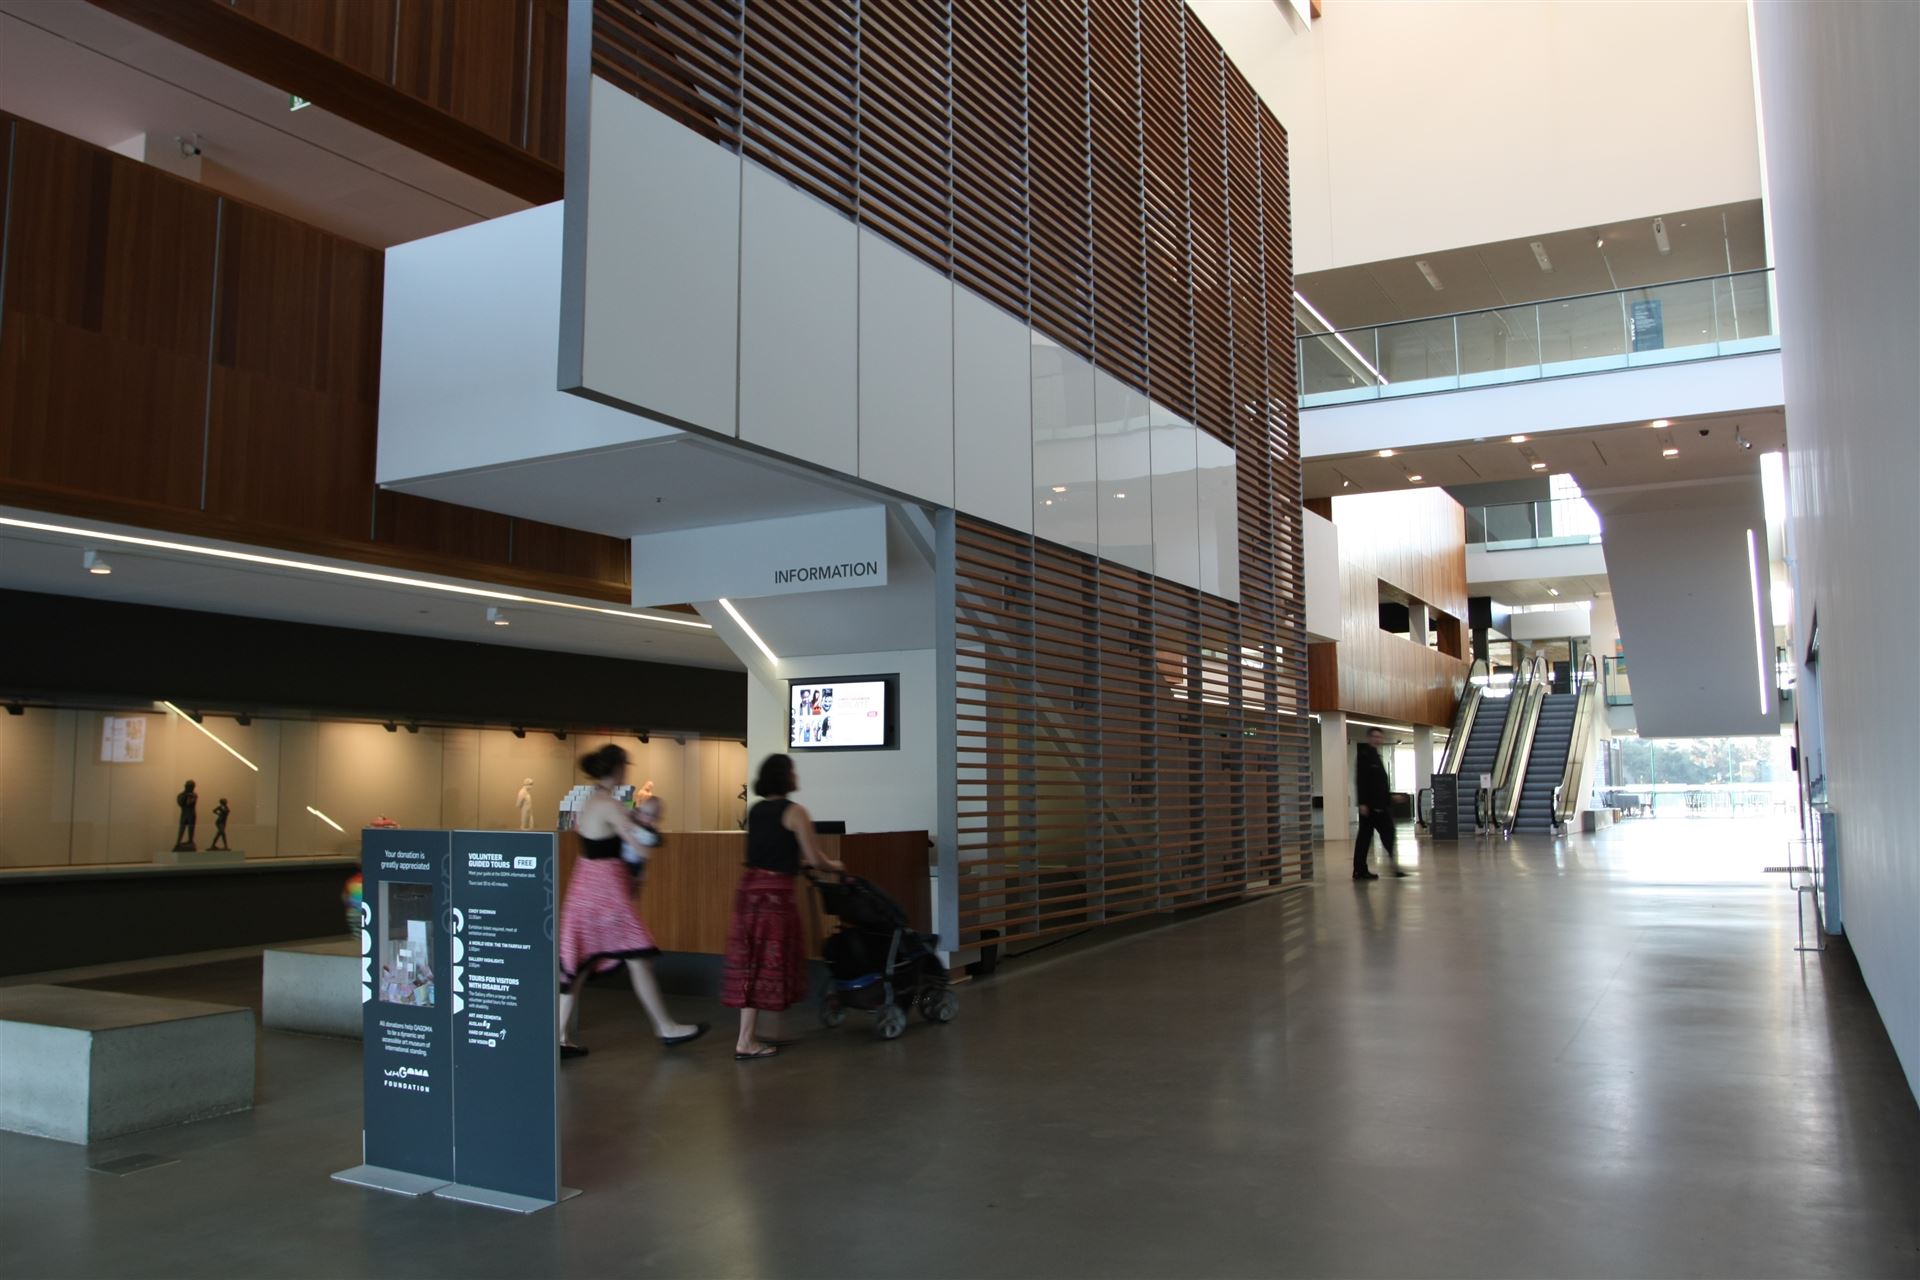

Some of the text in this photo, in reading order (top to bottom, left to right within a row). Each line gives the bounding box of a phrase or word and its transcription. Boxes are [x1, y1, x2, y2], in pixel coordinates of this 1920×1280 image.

[774, 561, 878, 584] INFORMATION
[380, 862, 399, 870] greatly
[497, 977, 519, 985] VISITORS
[482, 983, 510, 991] DISABILITY
[384, 1080, 430, 1092] FOUNDATION
